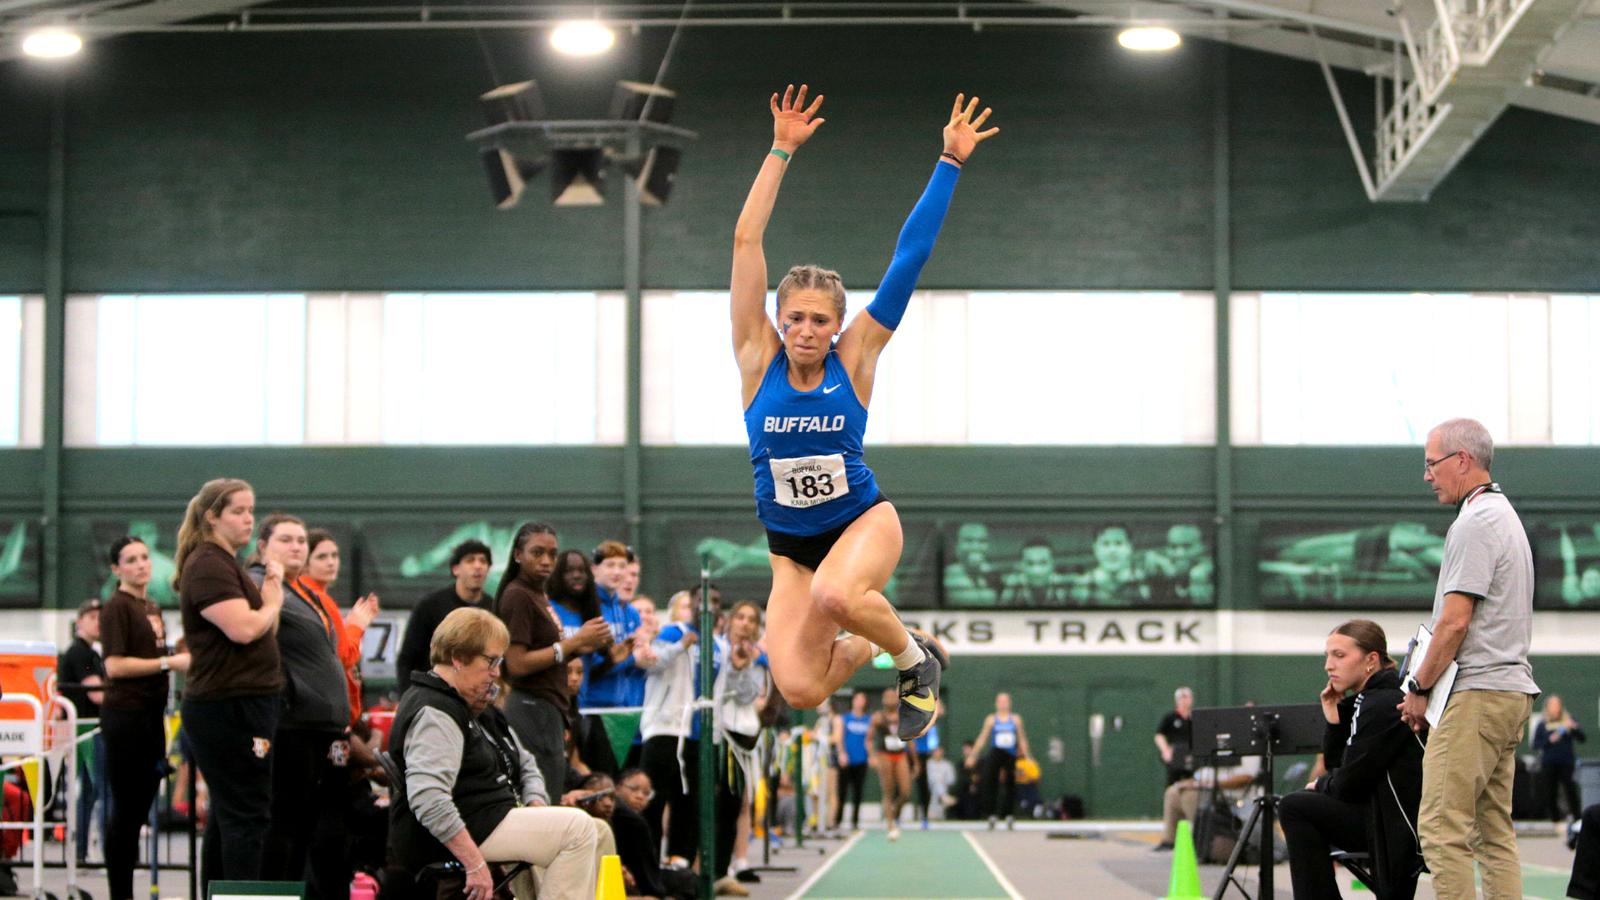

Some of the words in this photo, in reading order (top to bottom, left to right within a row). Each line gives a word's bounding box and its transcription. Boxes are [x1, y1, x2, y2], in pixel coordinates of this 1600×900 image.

[763, 415, 845, 433] BUFFALO
[791, 464, 822, 474] BUFFALO
[786, 473, 834, 498] 183
[367, 622, 392, 662] 7
[1026, 620, 1200, 644] TRACK
